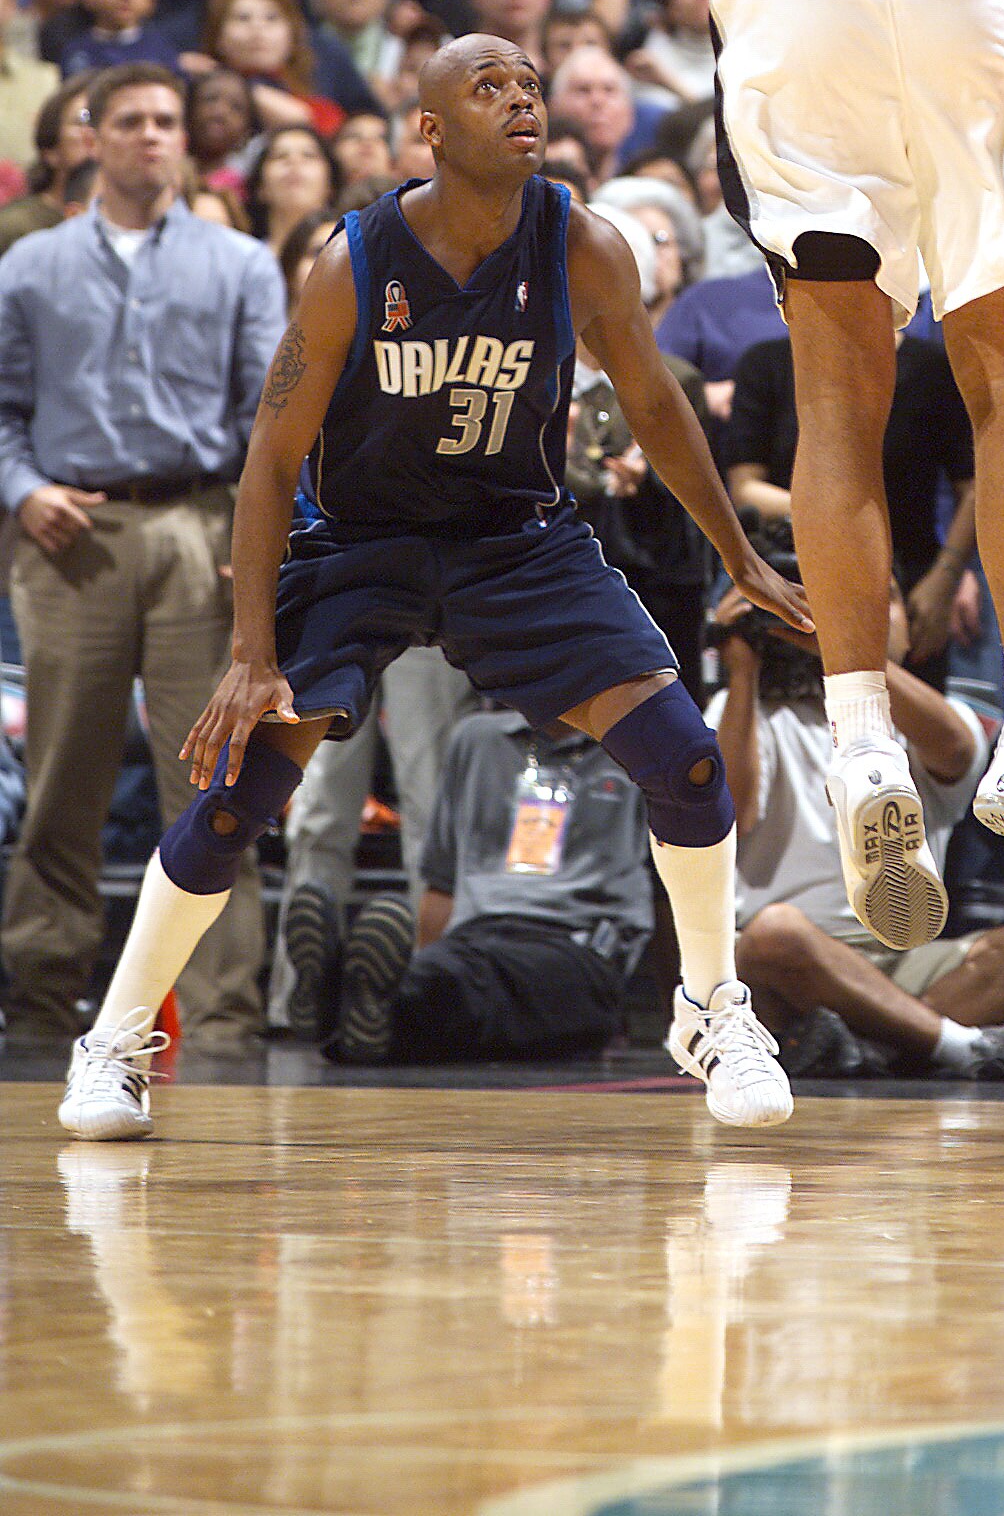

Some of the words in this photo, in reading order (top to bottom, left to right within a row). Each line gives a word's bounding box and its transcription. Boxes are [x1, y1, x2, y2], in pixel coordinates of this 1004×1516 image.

[373, 334, 536, 398] DALLAS
[435, 387, 516, 457] 31
[863, 821, 880, 864] MAX
[904, 812, 920, 851] AIR
